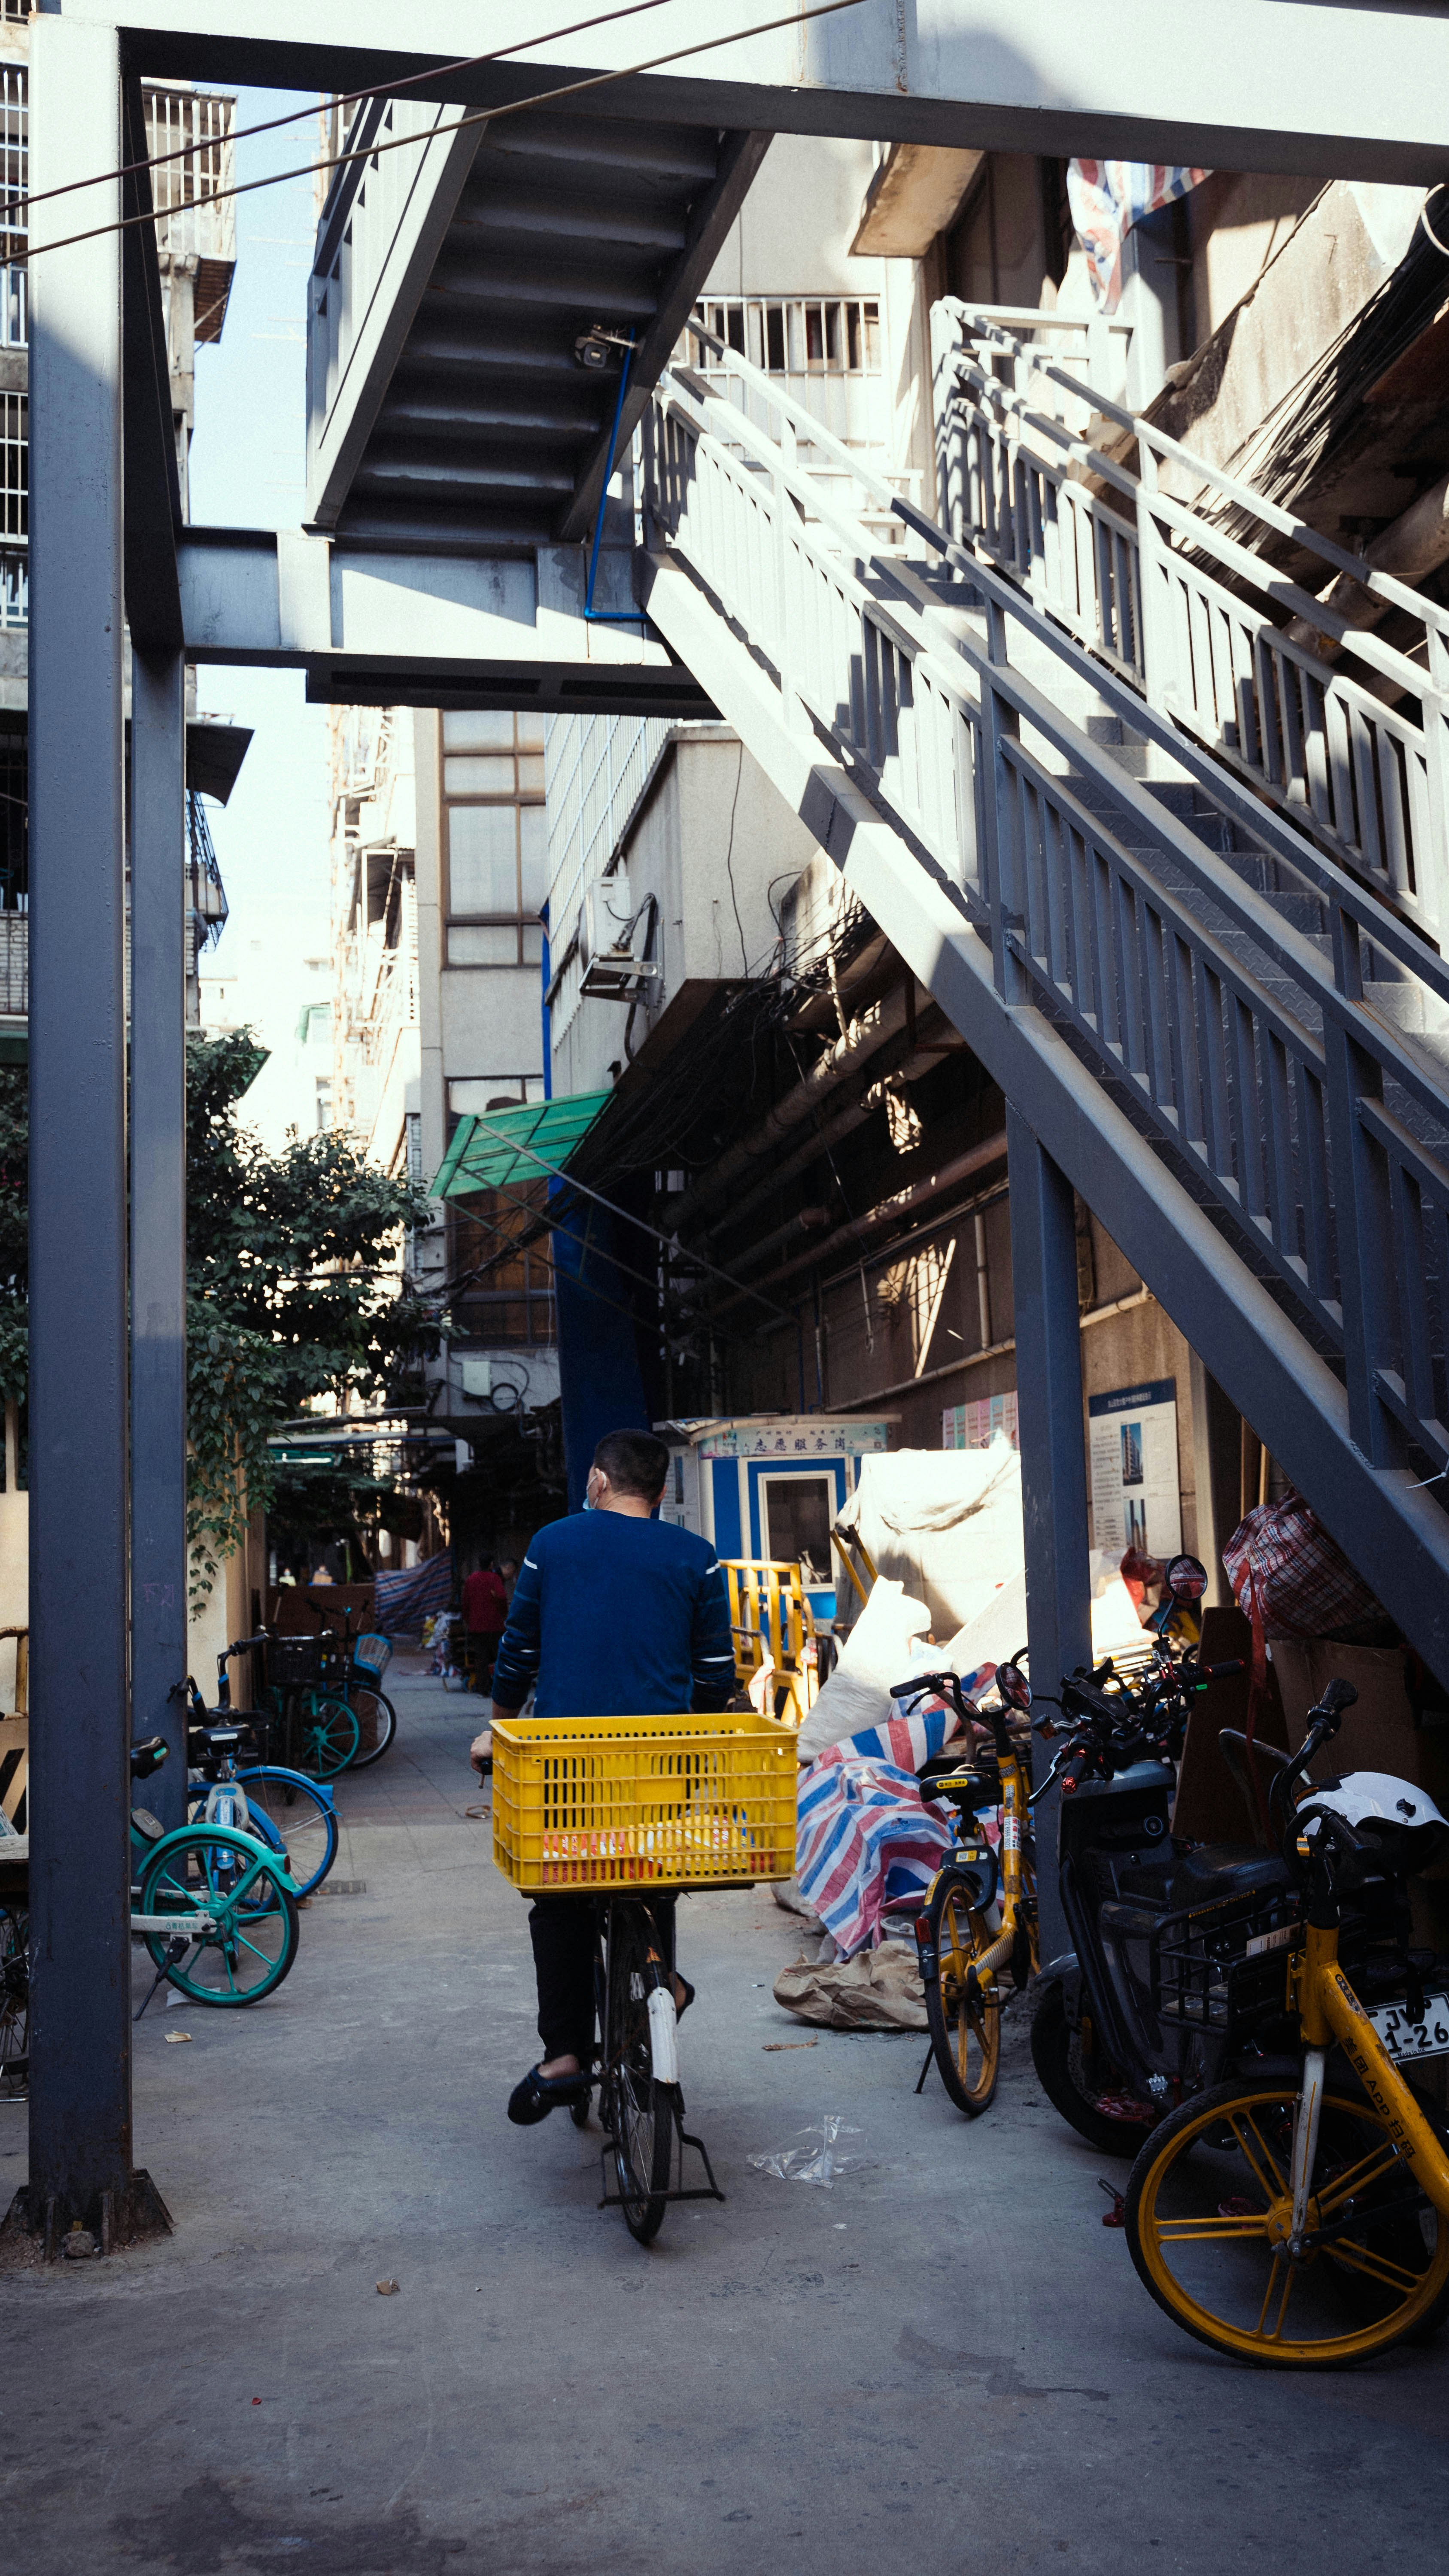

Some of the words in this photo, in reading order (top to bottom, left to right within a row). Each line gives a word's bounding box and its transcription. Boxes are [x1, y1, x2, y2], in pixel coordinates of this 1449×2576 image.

[754, 1437, 845, 1452] 志愿服务岗
[1385, 2022, 1449, 2053] 1-26
[1342, 2036, 1370, 2075] 美团
[1366, 2080, 1390, 2116] App
[1388, 2119, 1416, 2159] 扫码
